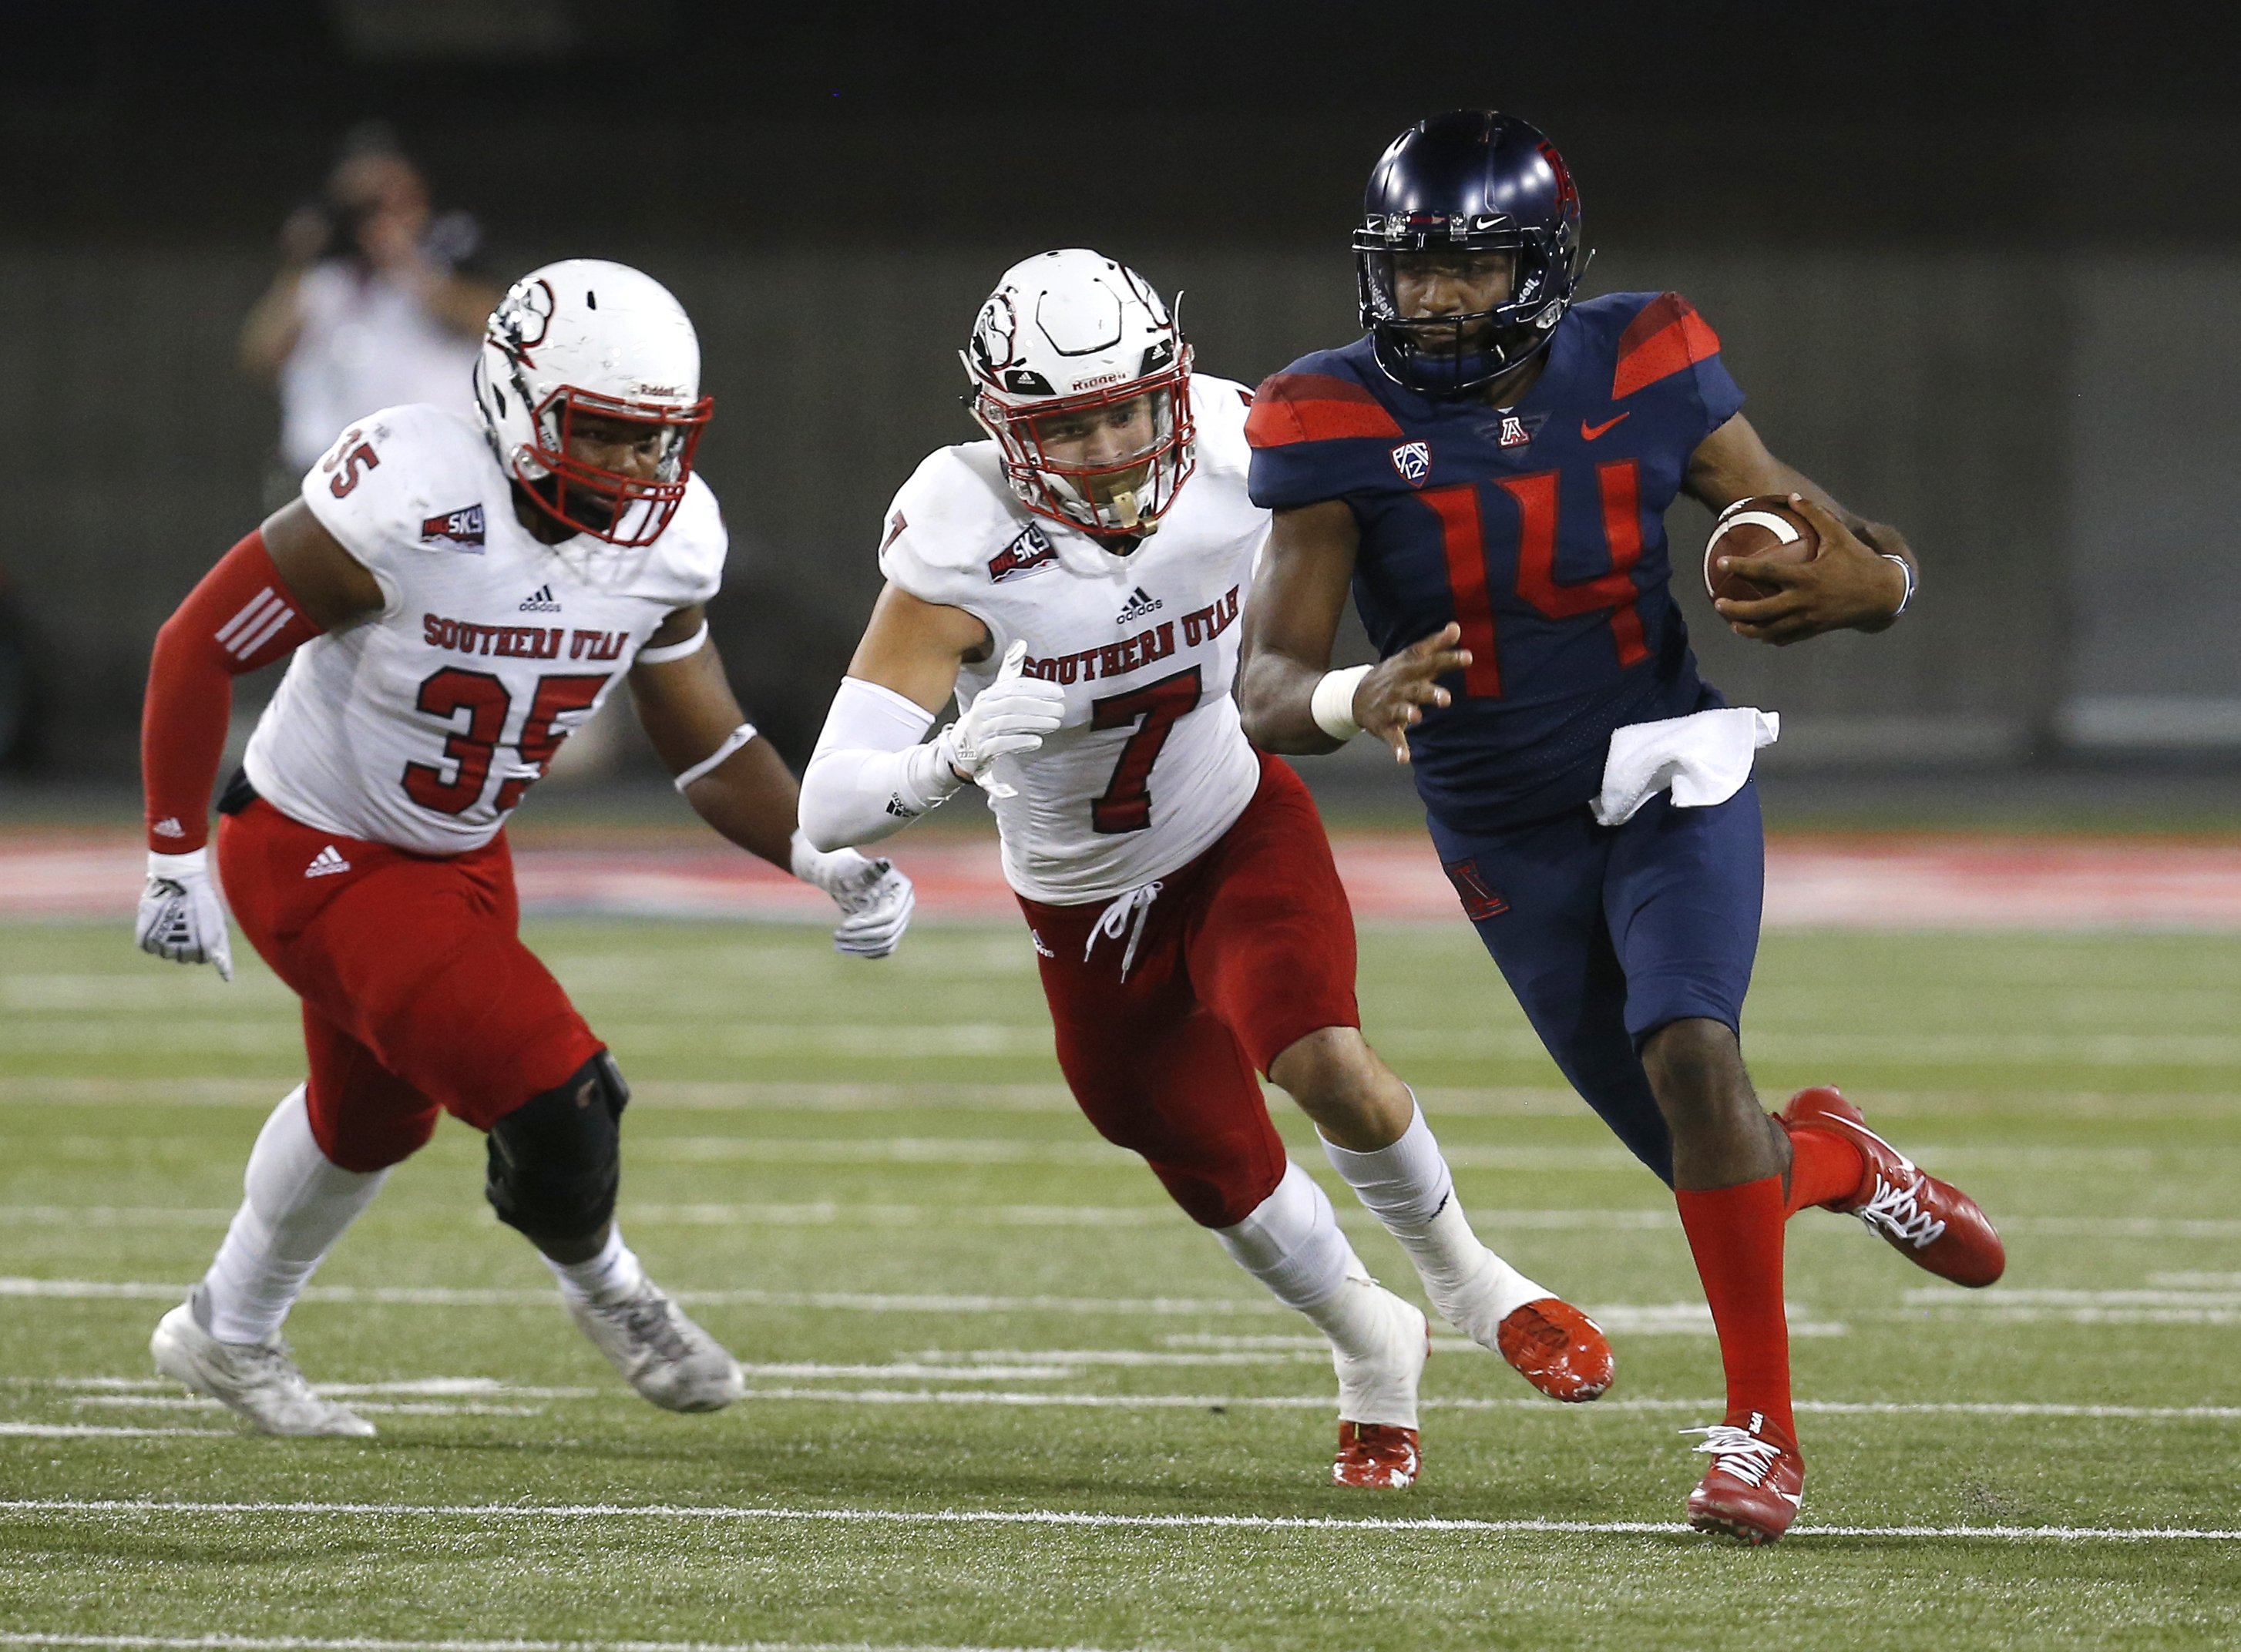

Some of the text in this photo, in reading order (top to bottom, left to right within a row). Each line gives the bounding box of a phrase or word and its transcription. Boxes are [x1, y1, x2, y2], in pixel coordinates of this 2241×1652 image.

[1518, 278, 1540, 303] dell
[1500, 416, 1531, 446] A
[1392, 442, 1430, 474] PAC
[1405, 459, 1426, 480] 12
[449, 505, 485, 534] SKY
[1012, 525, 1049, 562] SKY
[1413, 458, 1655, 700] 14
[1117, 599, 1164, 625] adidas
[1023, 583, 1240, 685] SOUTHERN UTAH
[400, 665, 615, 816] 35
[1090, 663, 1203, 834] 7
